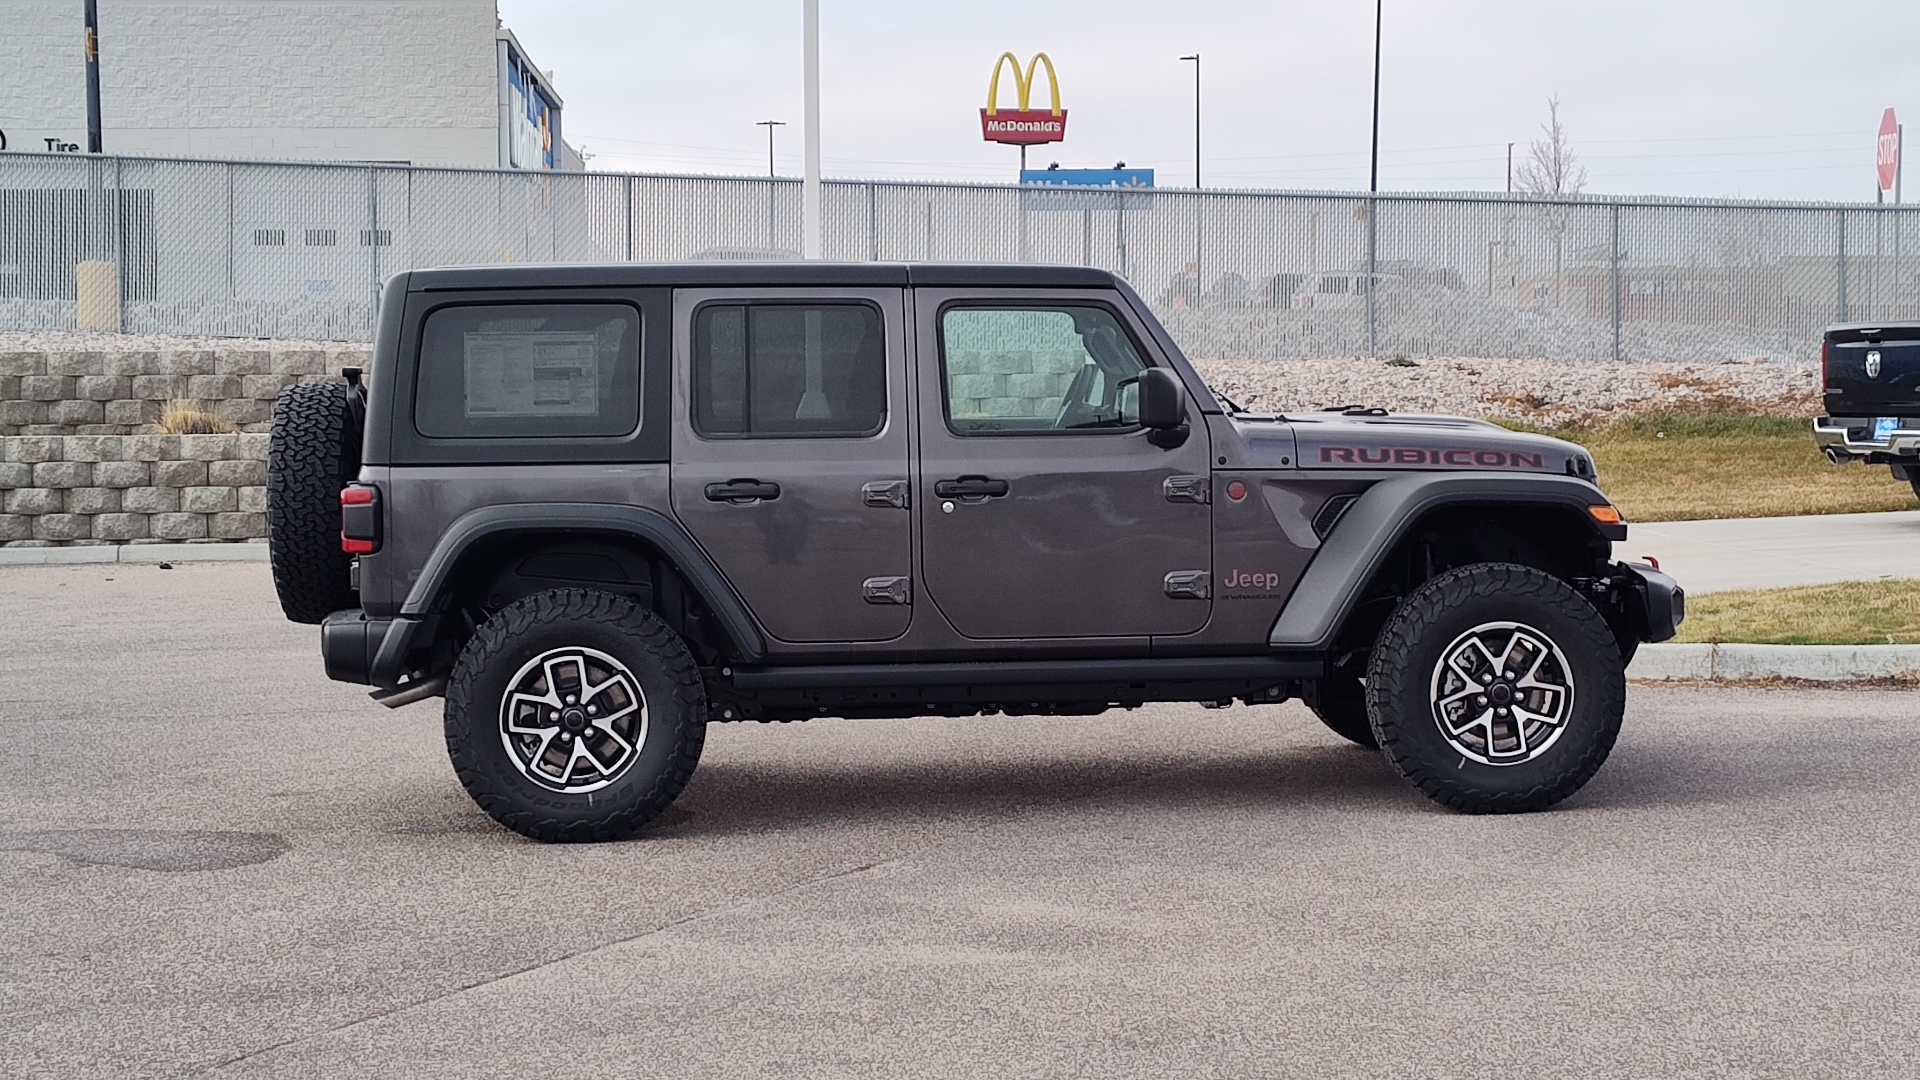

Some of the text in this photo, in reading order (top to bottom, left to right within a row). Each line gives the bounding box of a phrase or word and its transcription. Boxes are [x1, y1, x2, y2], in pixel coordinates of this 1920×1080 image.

[987, 120, 1061, 132] McDonald's
[44, 138, 79, 152] Tire
[1878, 133, 1897, 165] STOP
[1319, 446, 1546, 468] RUBICON
[1224, 569, 1279, 590] Jeep
